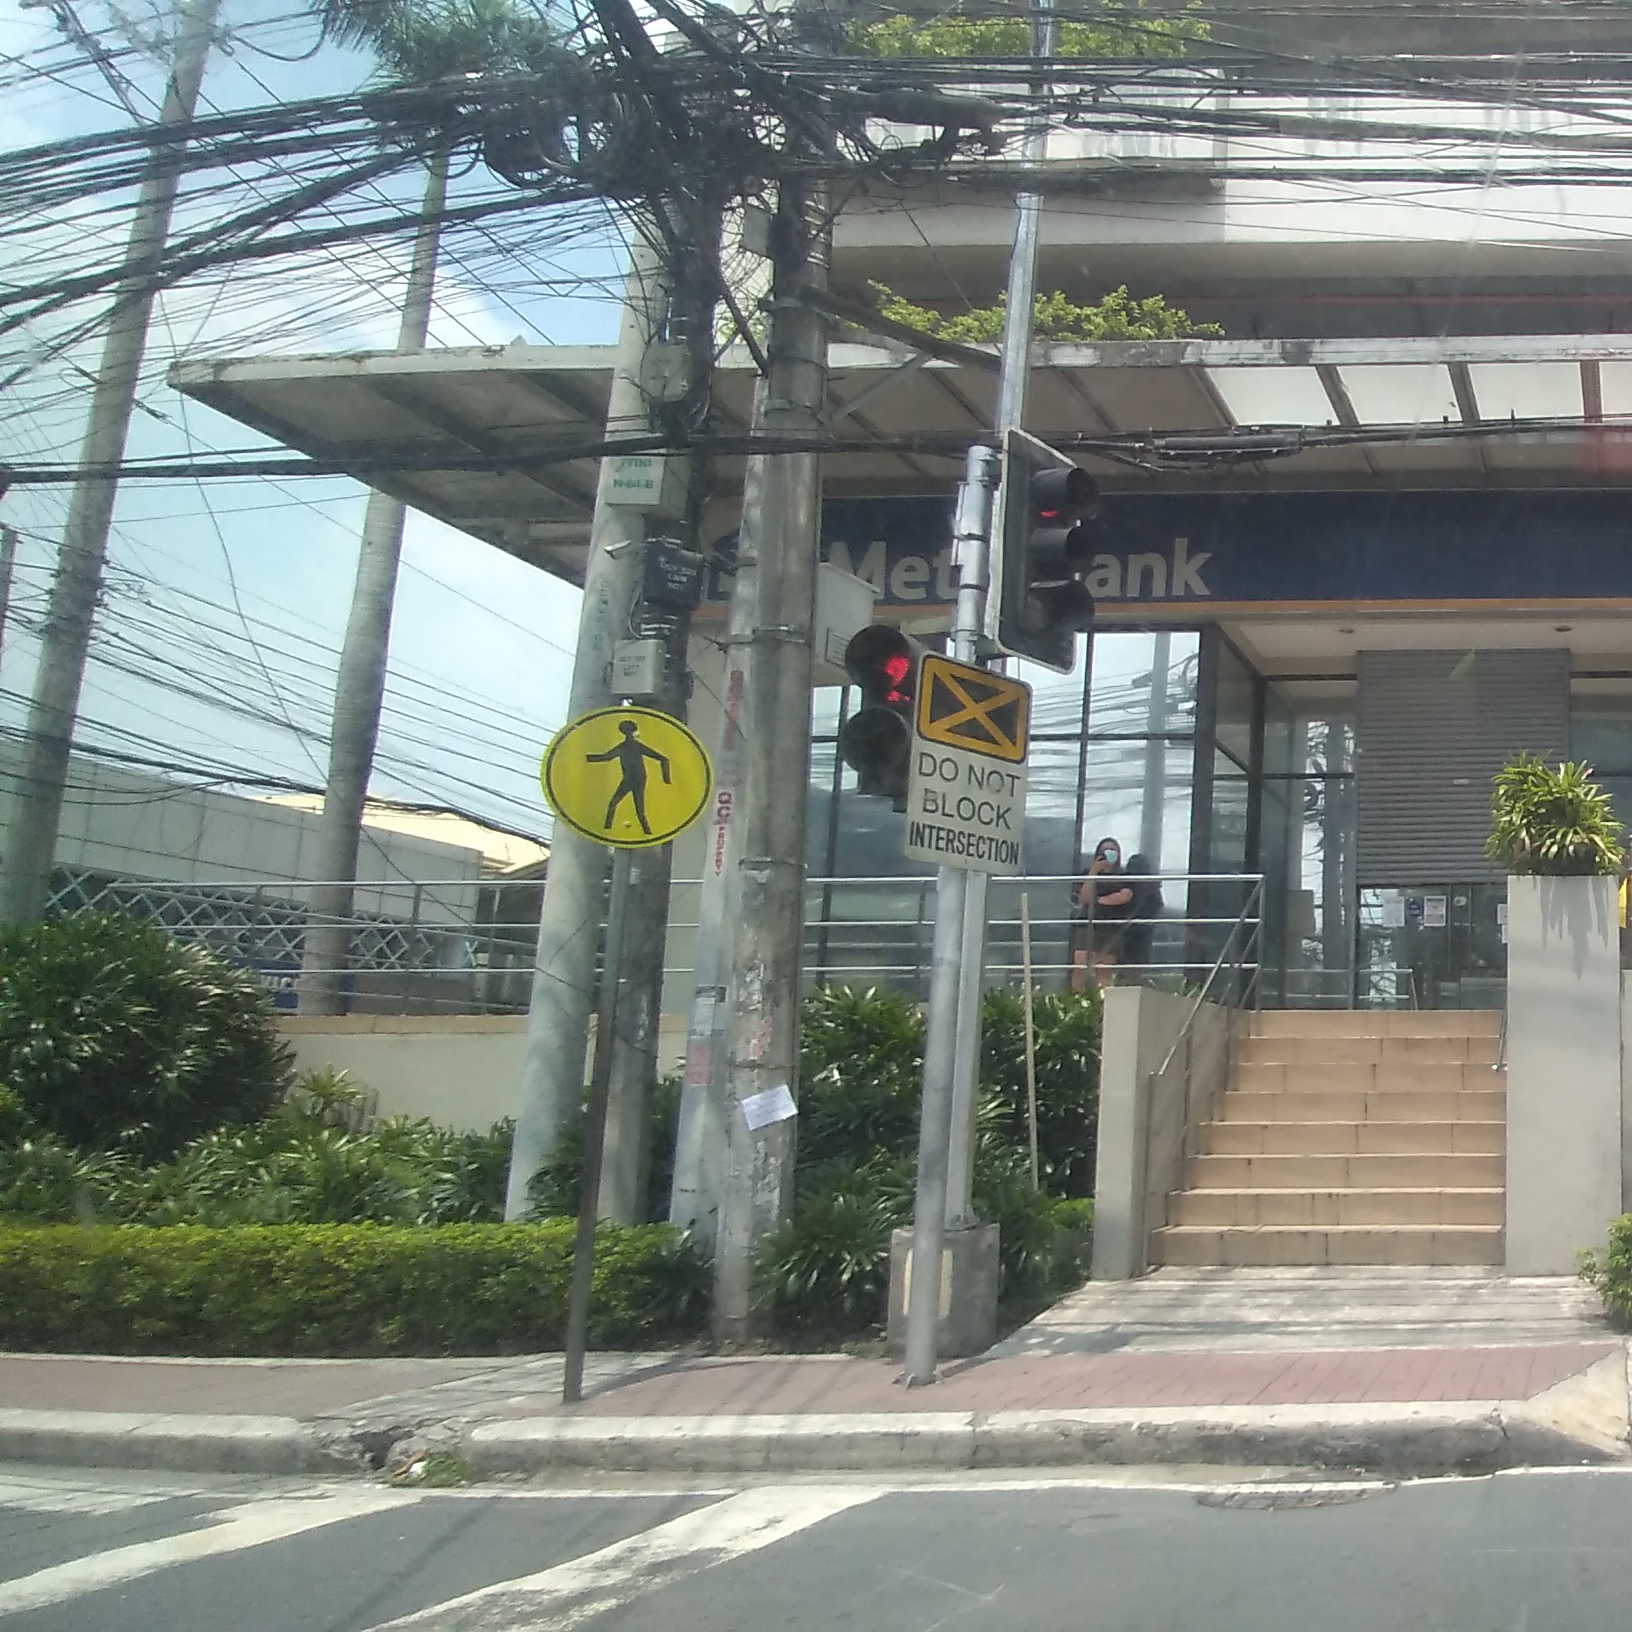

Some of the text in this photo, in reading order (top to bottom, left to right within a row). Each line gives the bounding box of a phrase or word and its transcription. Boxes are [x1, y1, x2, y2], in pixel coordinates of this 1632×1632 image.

[918, 751, 1021, 797] DO NOT
[922, 787, 1011, 830] BLOCK
[909, 820, 1020, 866] INTERSECTION
